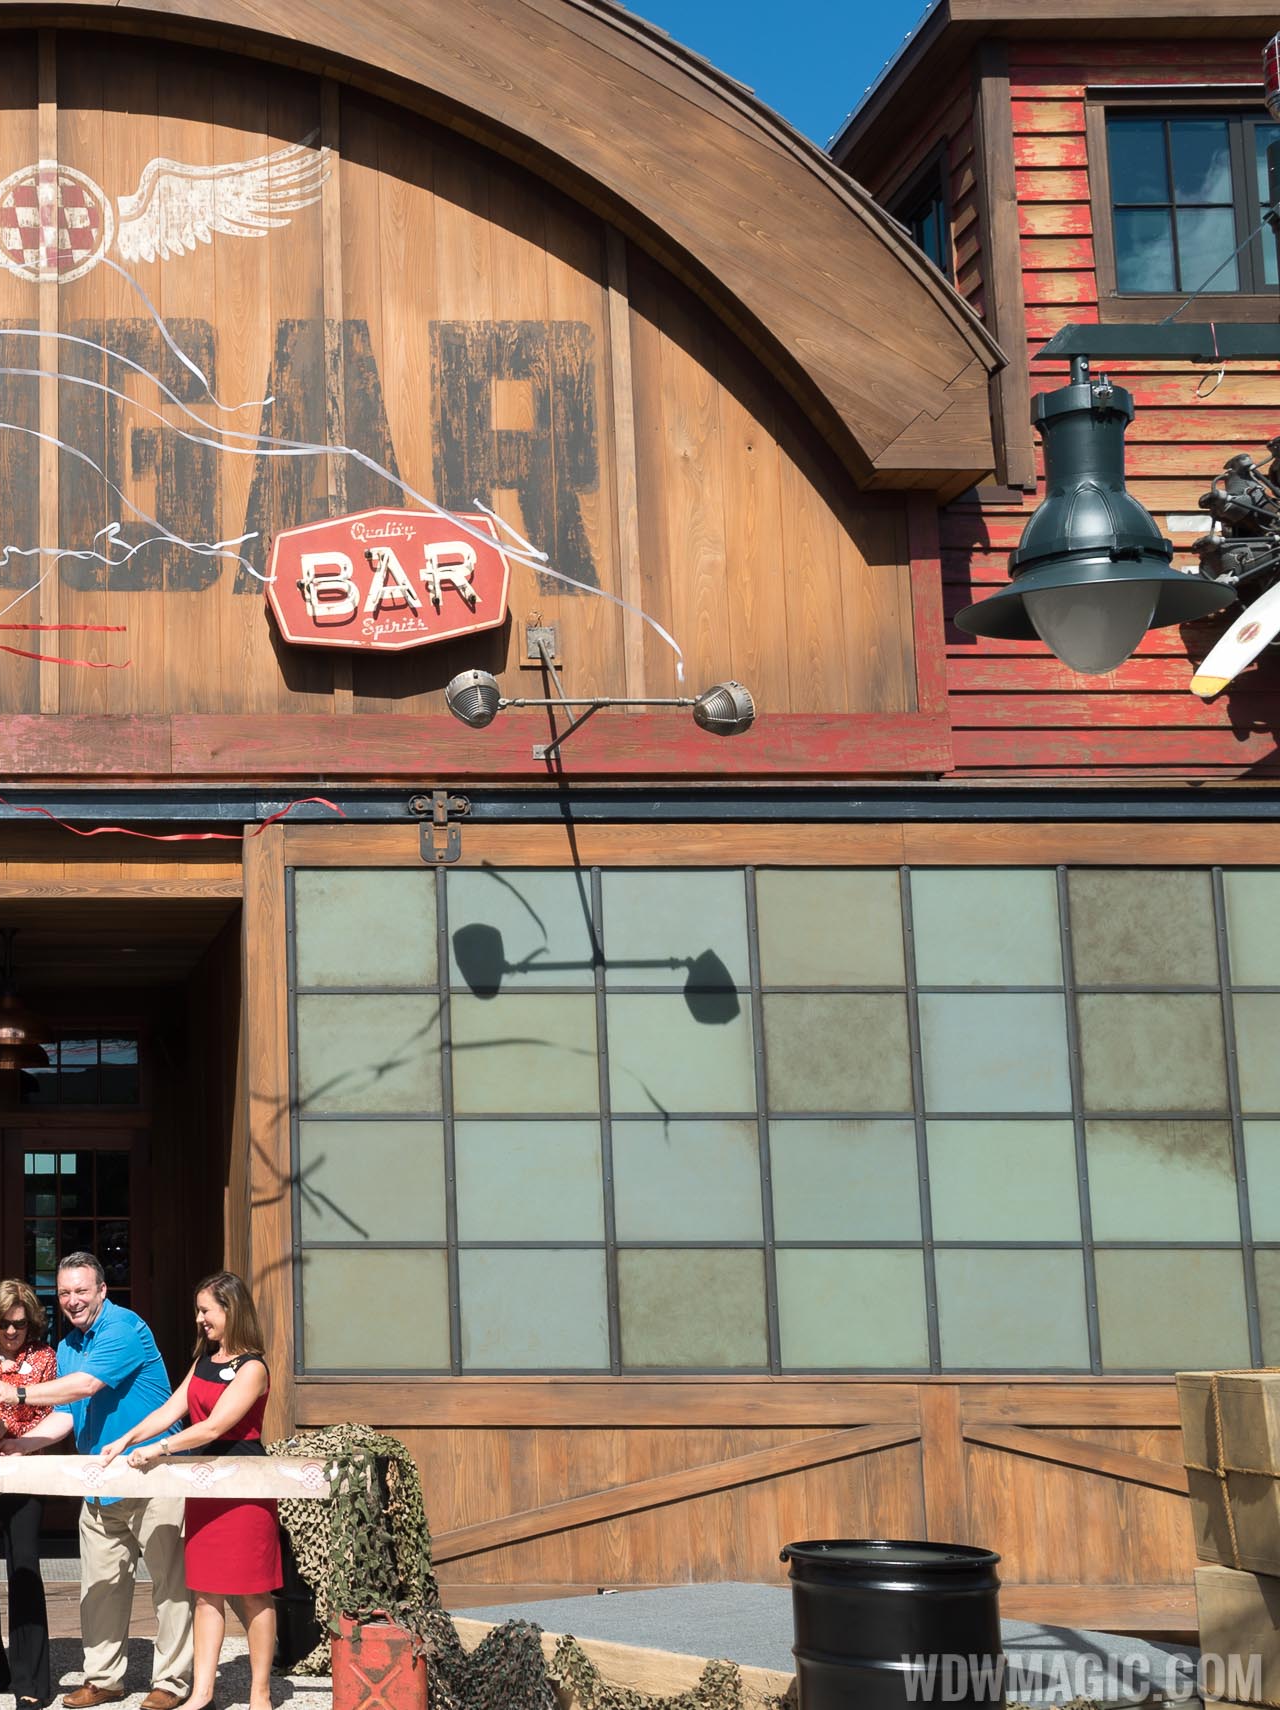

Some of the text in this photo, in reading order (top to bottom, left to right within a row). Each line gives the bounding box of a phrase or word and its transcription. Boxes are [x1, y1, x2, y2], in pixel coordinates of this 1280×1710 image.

[350, 522, 417, 543] Quality
[298, 541, 483, 619] BAR
[361, 617, 429, 641] Spirits
